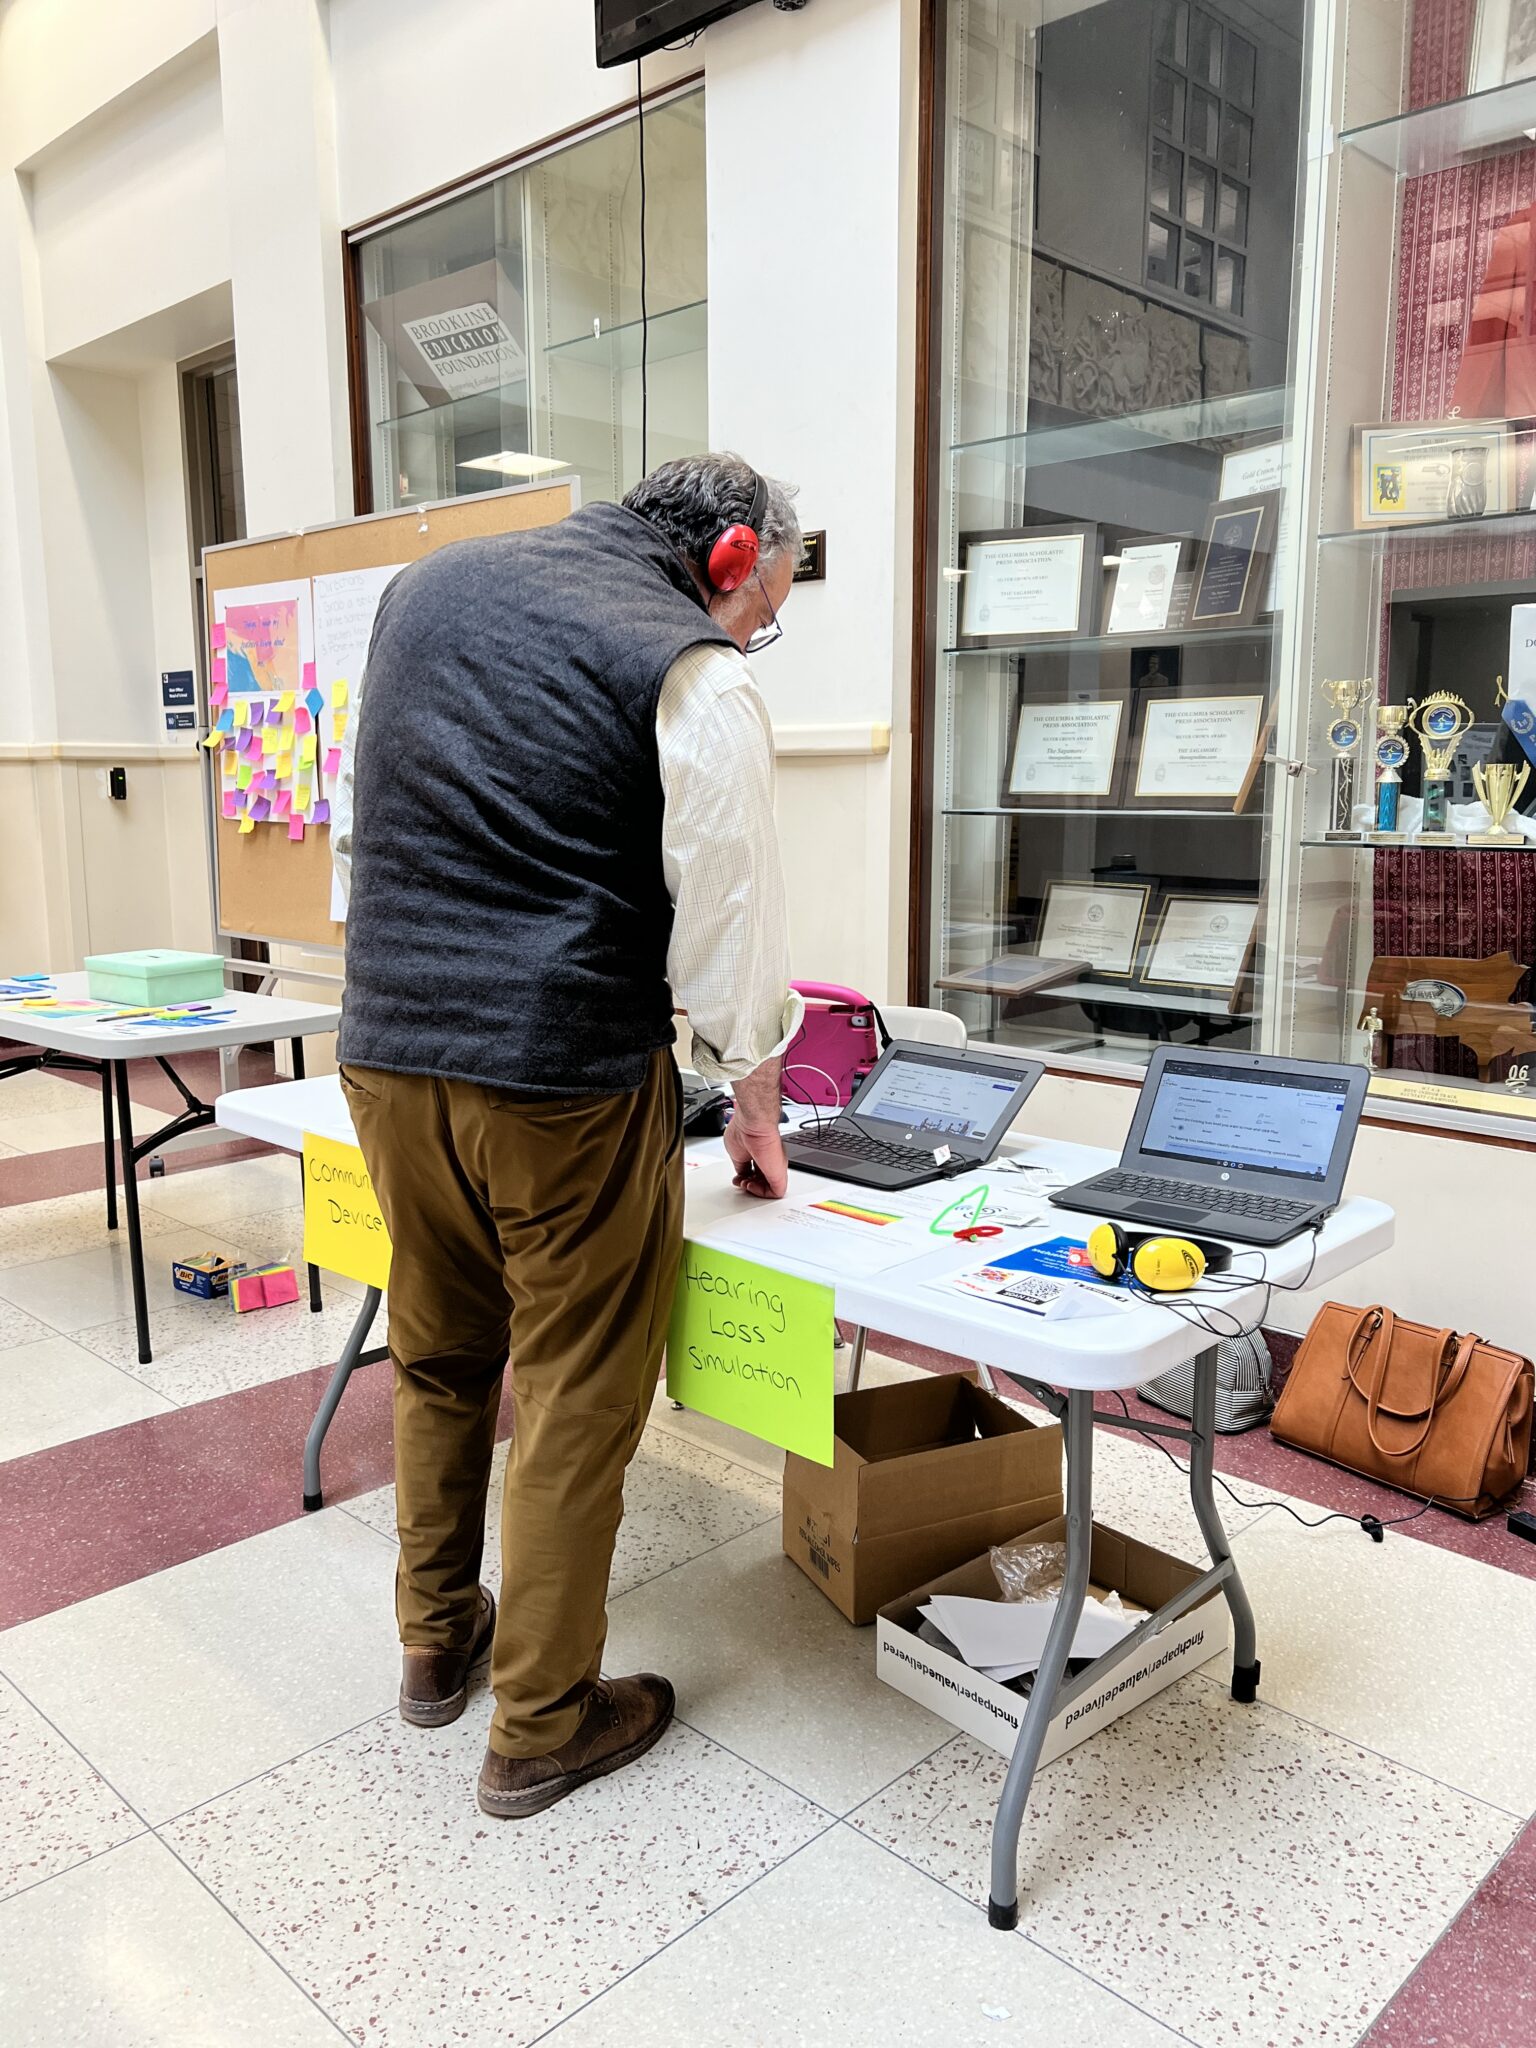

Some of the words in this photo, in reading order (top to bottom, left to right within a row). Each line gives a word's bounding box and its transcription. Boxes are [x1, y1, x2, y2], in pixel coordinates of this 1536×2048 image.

[410, 307, 495, 340] BROOKLINE
[423, 324, 506, 359] EDUCATION
[434, 344, 519, 376] FOUNDATION
[1508, 1064, 1529, 1080] 06
[327, 1199, 382, 1231] Device
[685, 1258, 786, 1333] Hearing
[708, 1308, 765, 1343] Loss
[688, 1346, 802, 1399] Simulation
